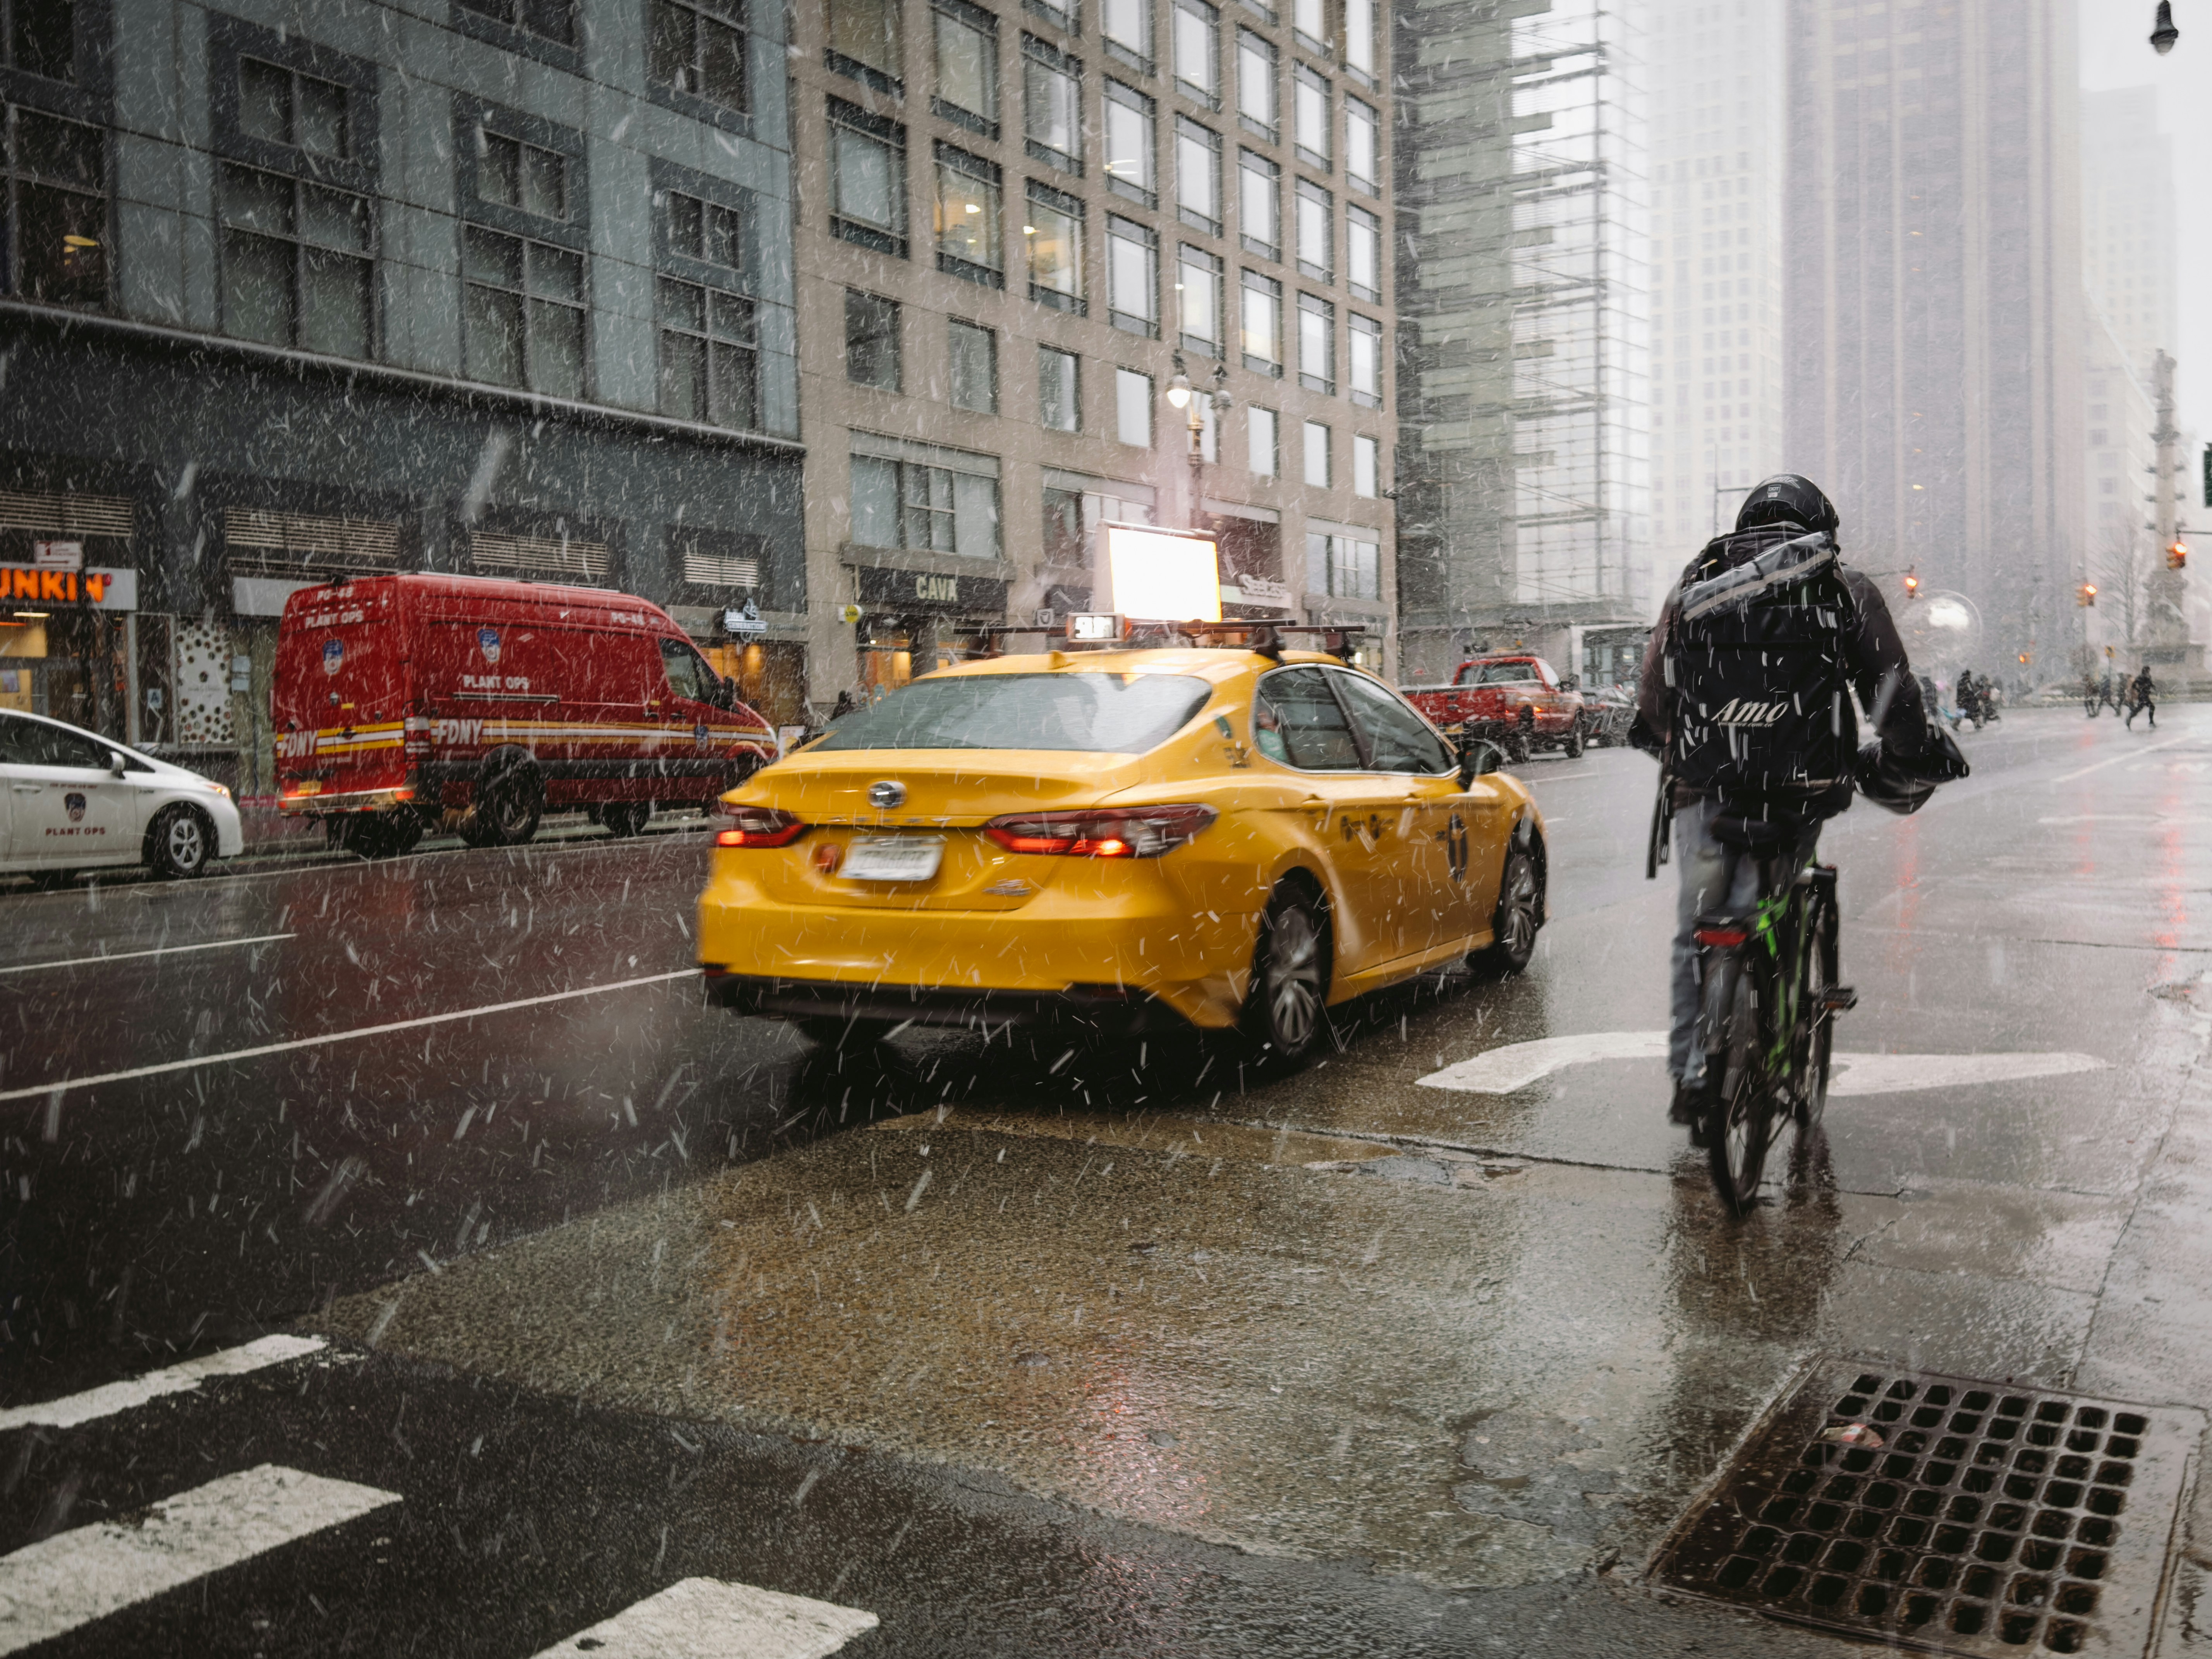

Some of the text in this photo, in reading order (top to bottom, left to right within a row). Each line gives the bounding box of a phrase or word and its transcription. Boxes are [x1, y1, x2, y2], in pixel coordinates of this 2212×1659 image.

[916, 576, 957, 601] CAVA
[305, 610, 364, 629] PLANT OPS
[728, 622, 764, 630] GENERATION
[463, 675, 529, 689] PLANT OPS
[151, 691, 160, 704] A
[437, 719, 483, 746] FDNY
[280, 730, 318, 758] FDNY
[46, 828, 81, 836] PLANT
